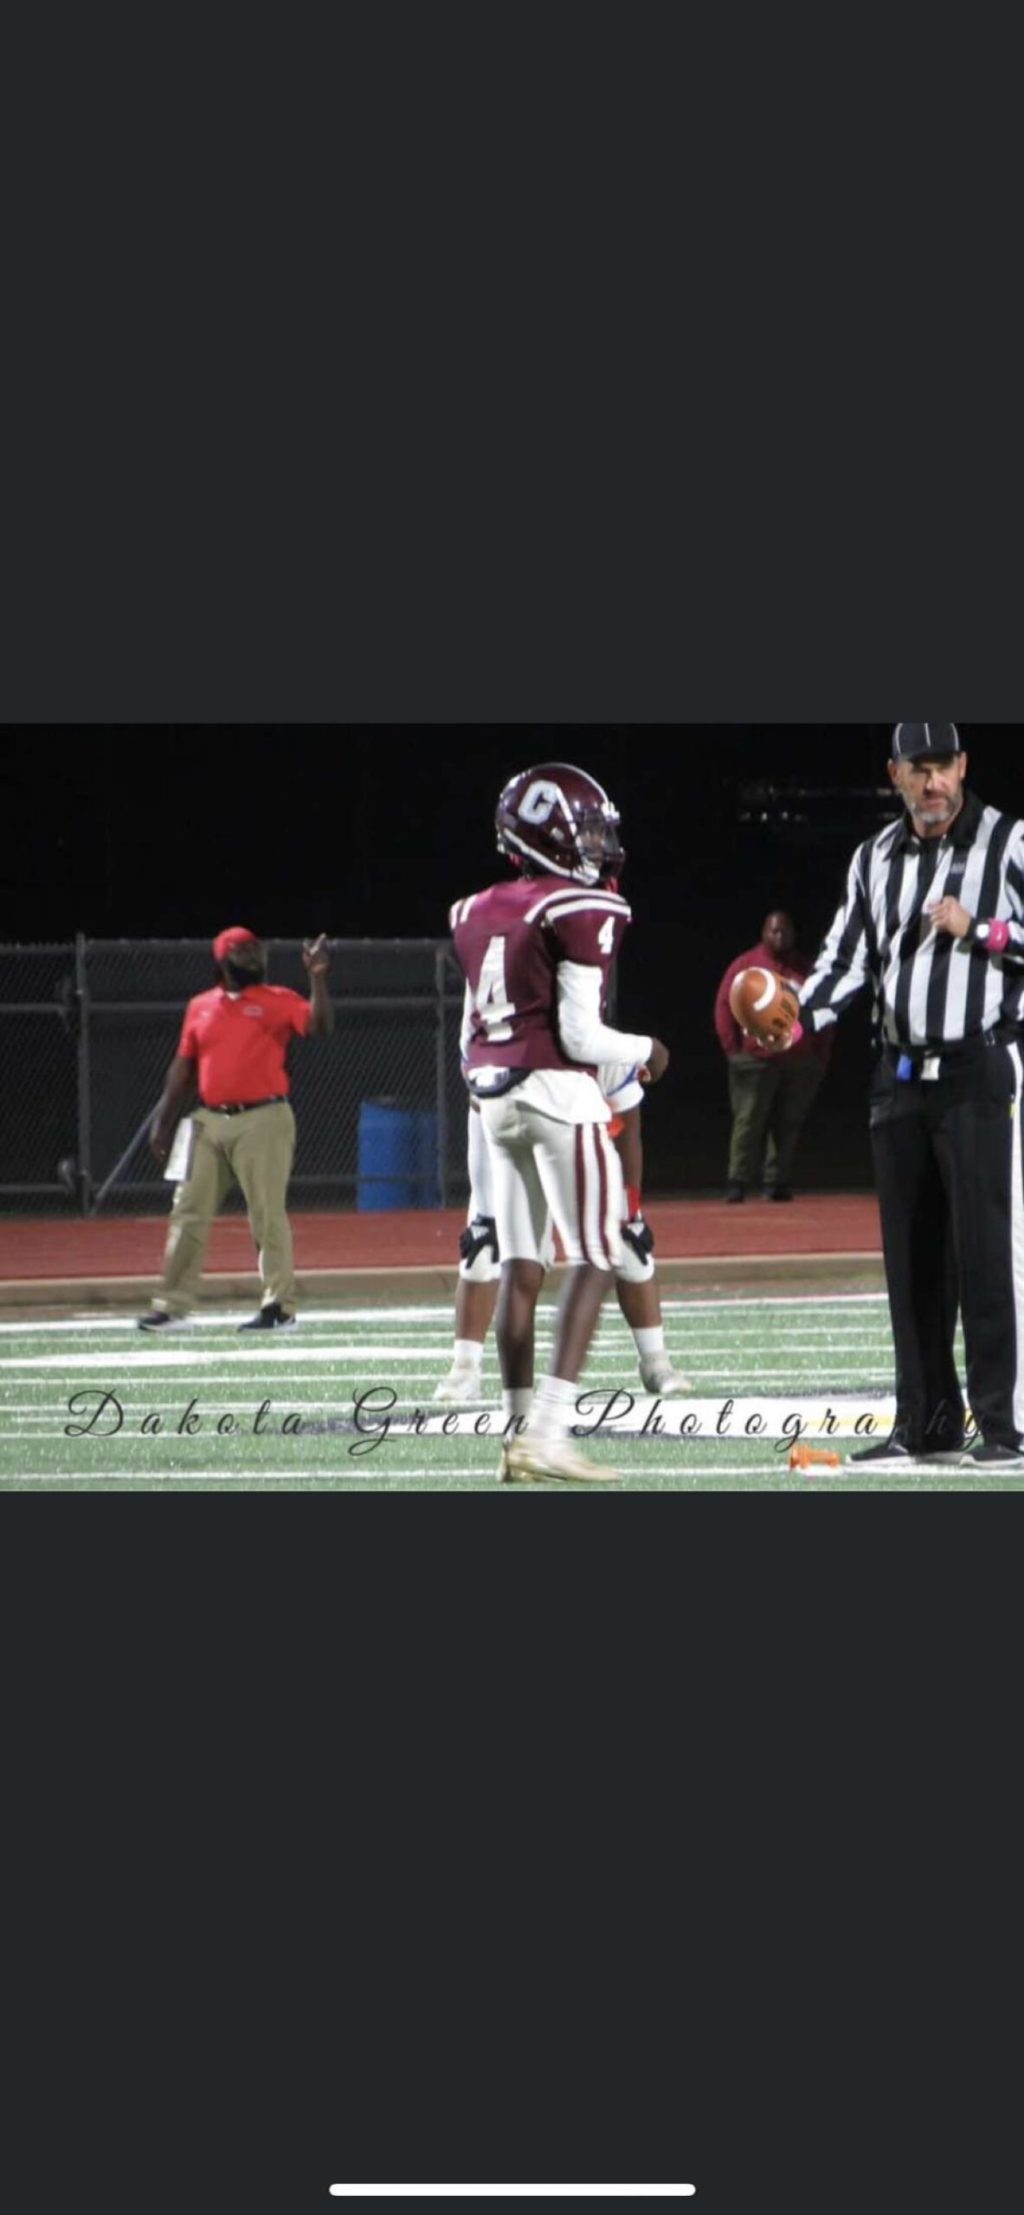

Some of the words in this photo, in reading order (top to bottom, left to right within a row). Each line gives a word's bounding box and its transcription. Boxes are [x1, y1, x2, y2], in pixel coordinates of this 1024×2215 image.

[518, 779, 559, 825] C
[597, 916, 615, 954] 4
[476, 936, 516, 1041] 4
